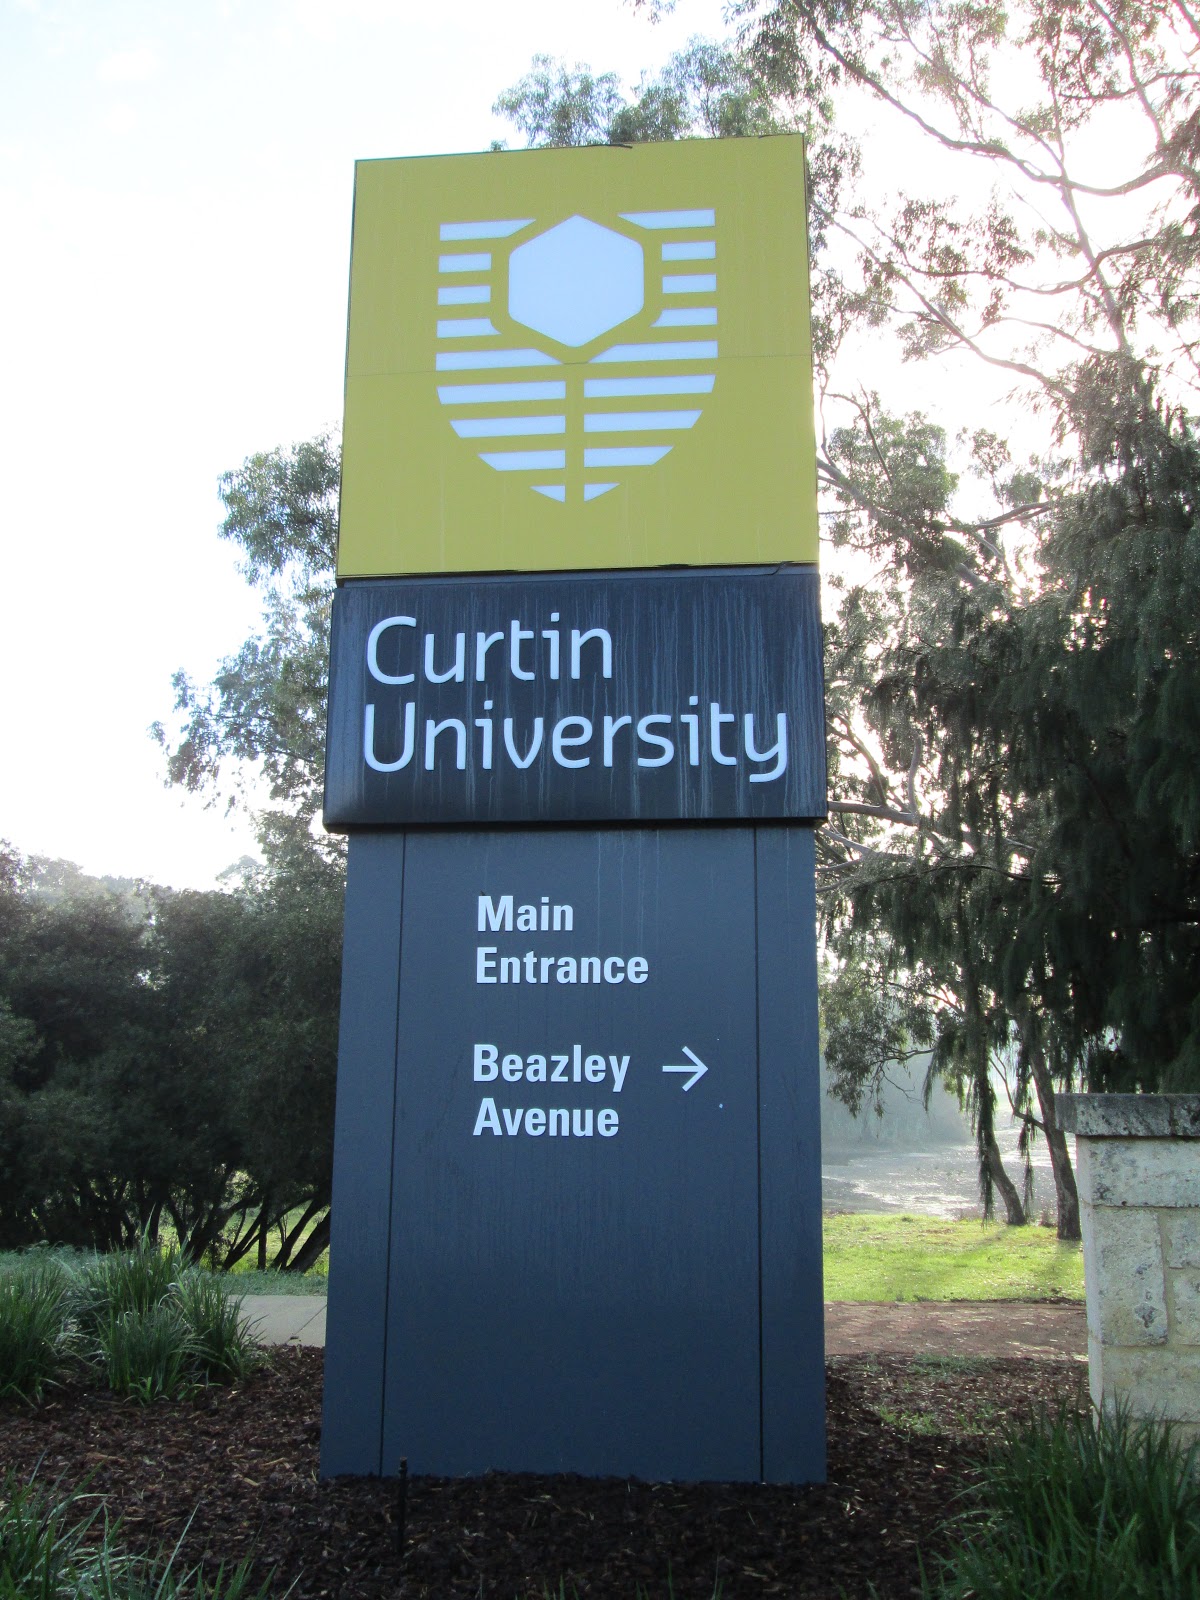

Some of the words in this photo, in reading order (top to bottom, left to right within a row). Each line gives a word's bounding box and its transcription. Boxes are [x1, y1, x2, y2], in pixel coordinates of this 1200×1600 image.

[367, 613, 612, 684] Curtin
[364, 696, 788, 783] University
[477, 895, 574, 932] Main
[476, 946, 649, 984] Entrance
[473, 1043, 631, 1092] Beazley
[473, 1097, 619, 1137] Avenue
